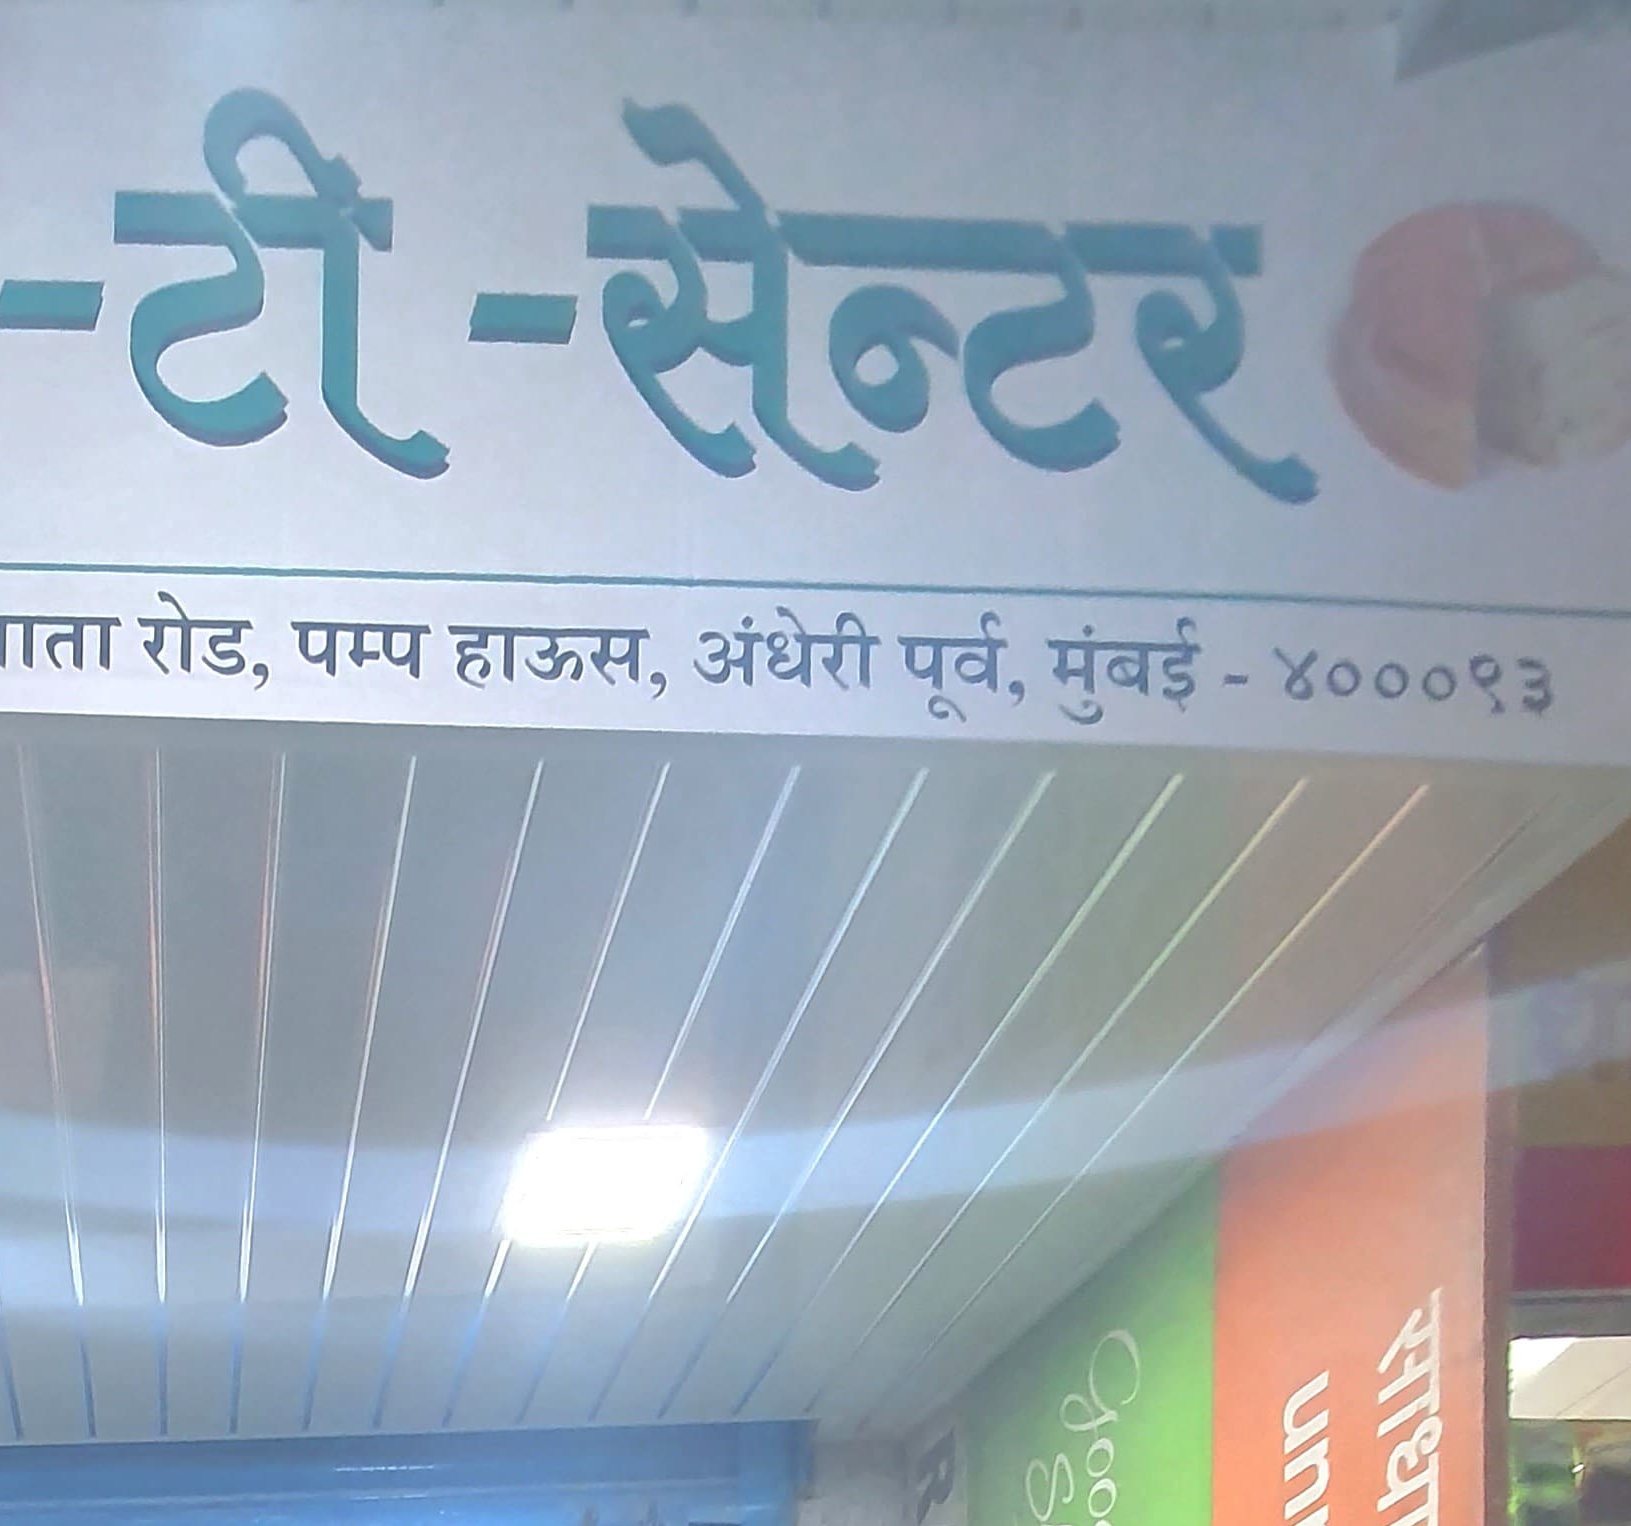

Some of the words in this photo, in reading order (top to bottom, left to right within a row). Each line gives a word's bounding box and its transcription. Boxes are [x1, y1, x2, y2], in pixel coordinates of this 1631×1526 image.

[137, 590, 270, 691] रोड,
[290, 620, 432, 680] पम्प
[447, 624, 668, 699] हाऊस,
[692, 606, 882, 690] अंधेरी
[897, 610, 1026, 722] पूर्व,
[1046, 616, 1203, 727] मुंबई
[1272, 644, 1555, 718] ४०००९३
